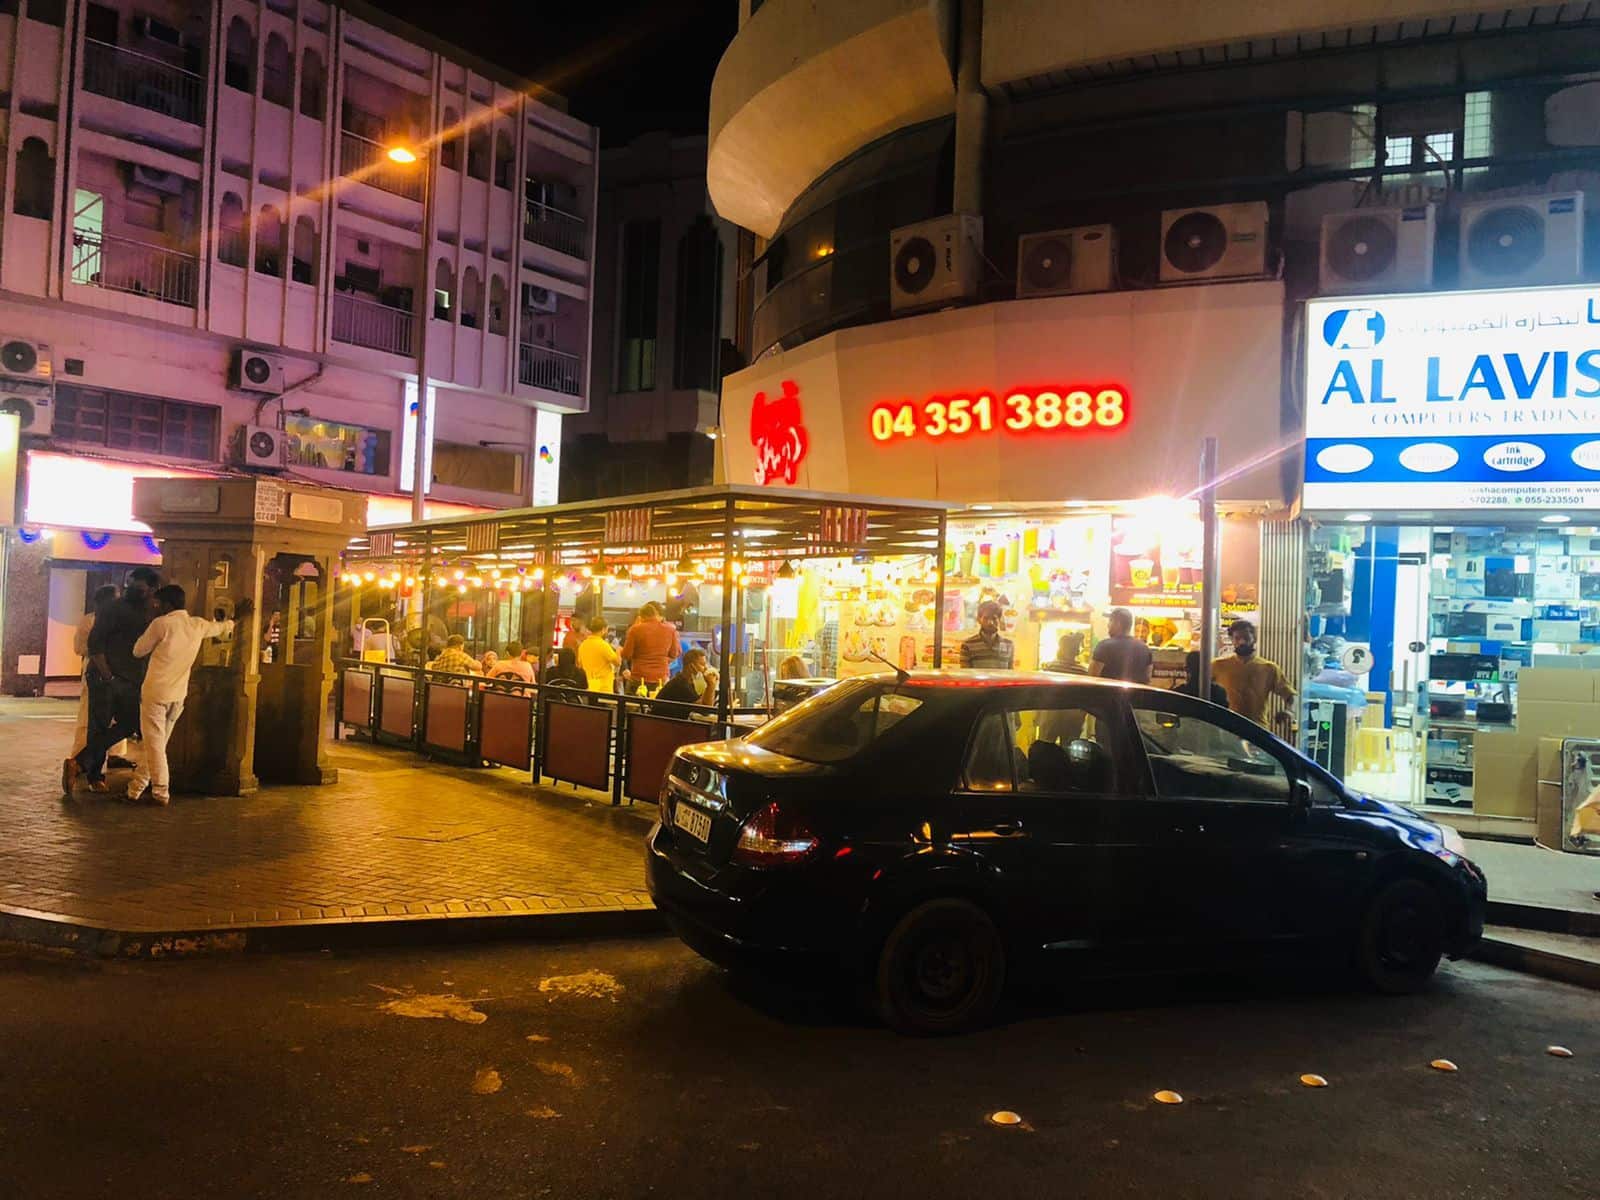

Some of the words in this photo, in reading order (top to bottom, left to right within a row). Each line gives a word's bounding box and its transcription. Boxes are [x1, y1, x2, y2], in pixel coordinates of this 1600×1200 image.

[1321, 359, 1397, 404] AL
[872, 405, 916, 440] 04
[924, 397, 992, 436] 351
[1006, 389, 1125, 430] 3888
